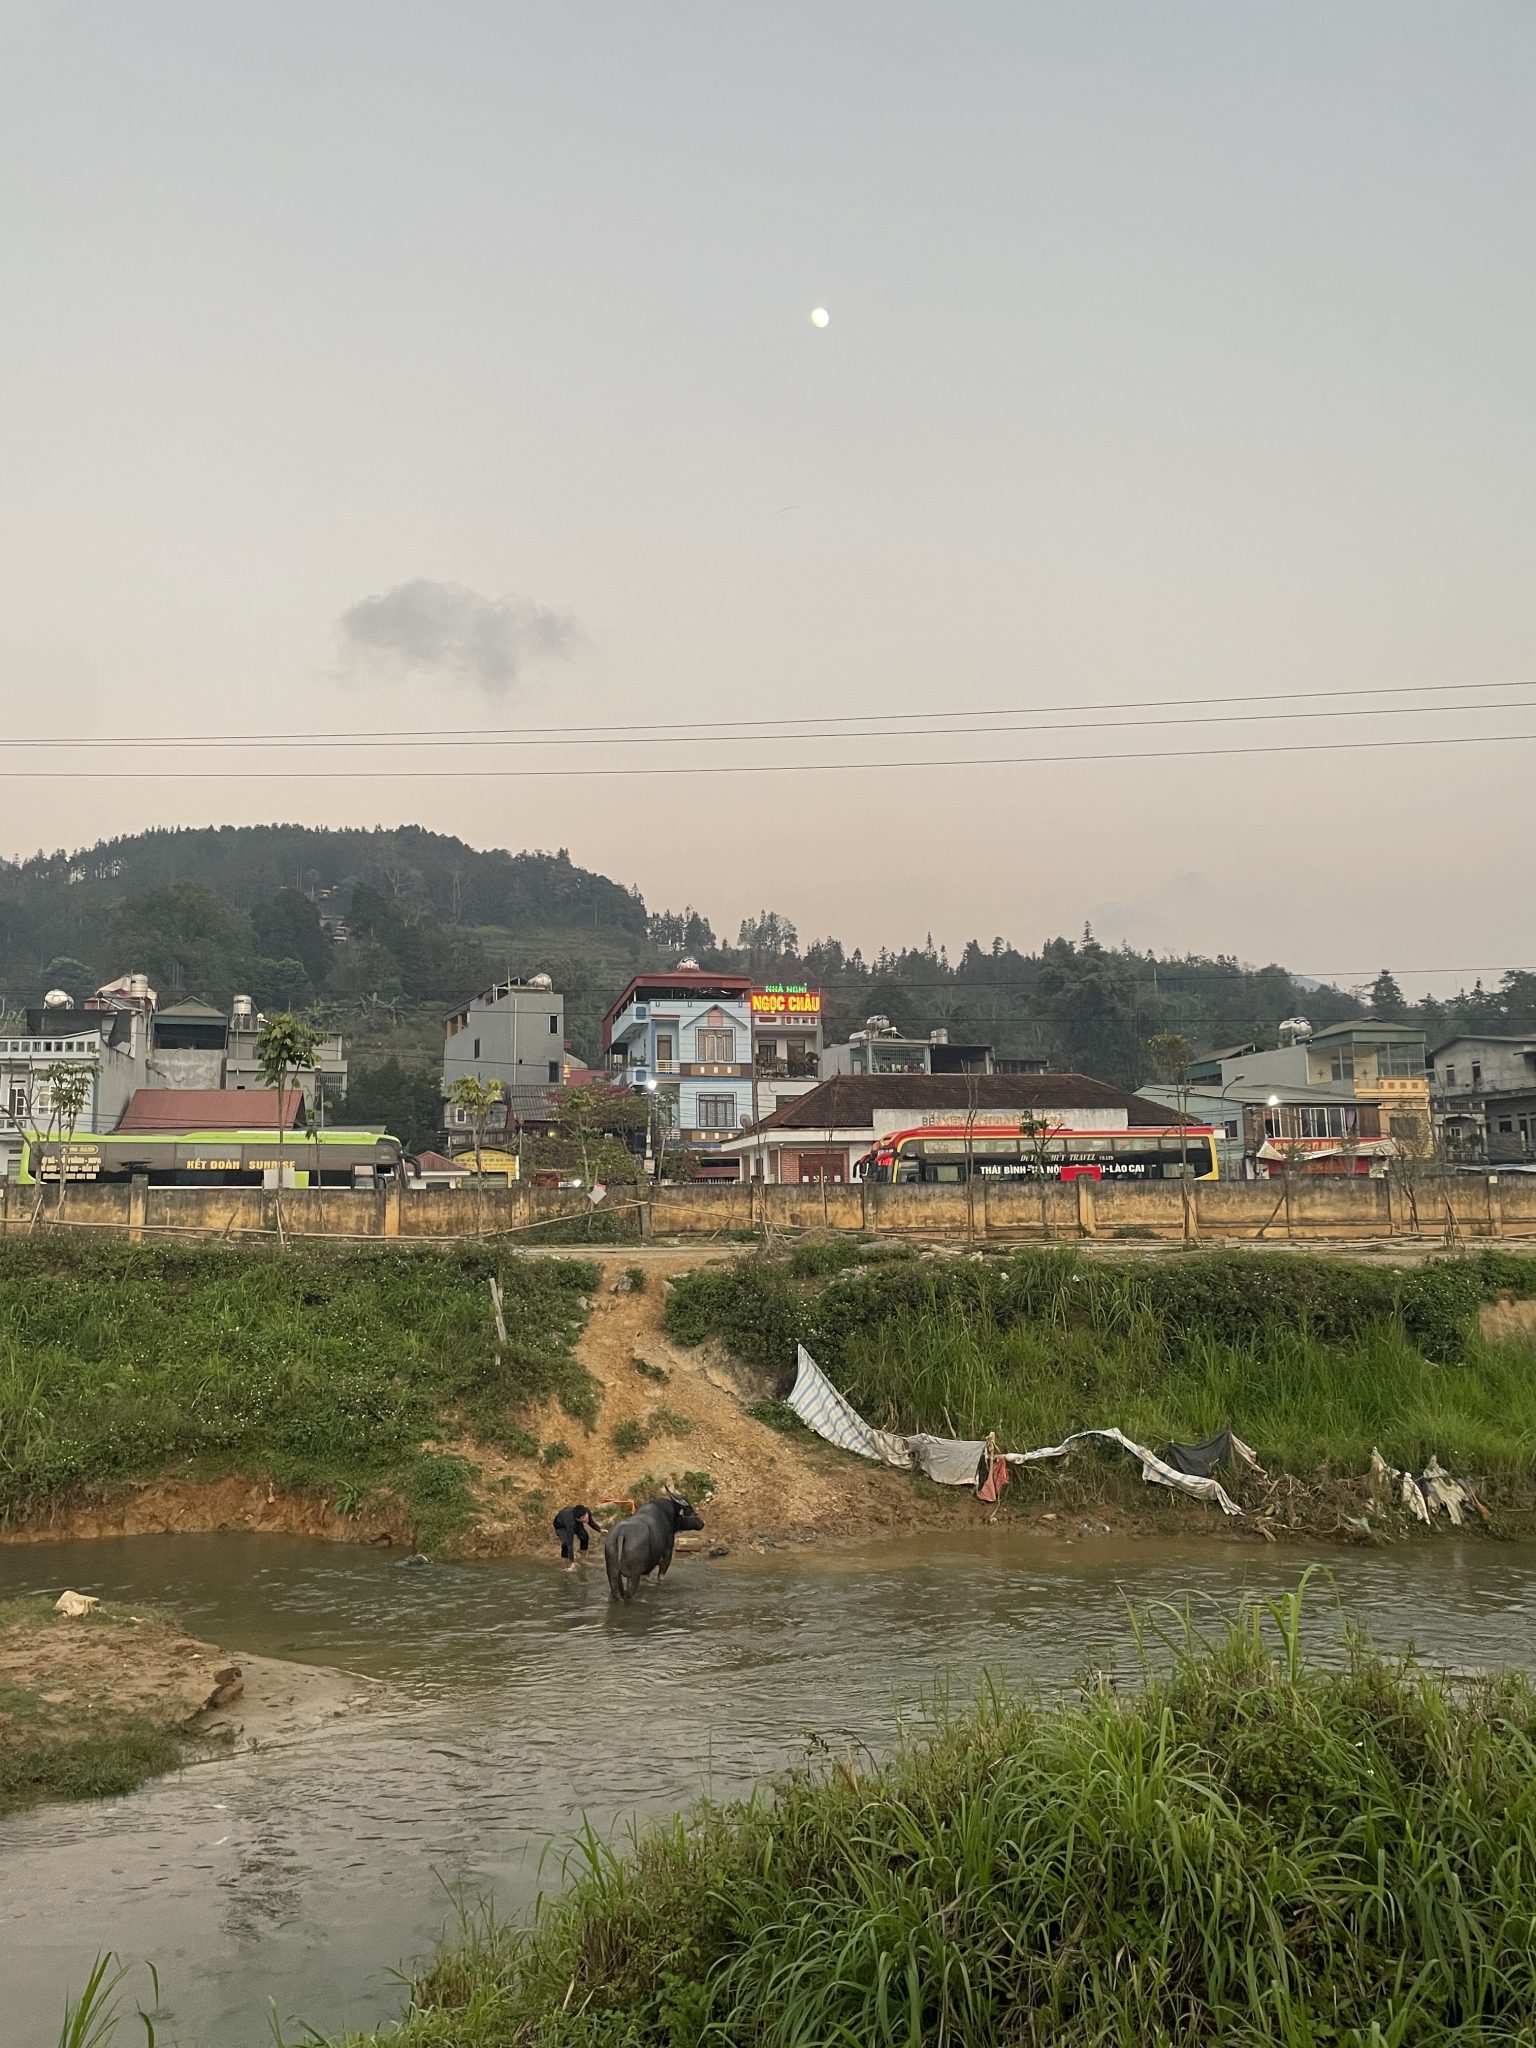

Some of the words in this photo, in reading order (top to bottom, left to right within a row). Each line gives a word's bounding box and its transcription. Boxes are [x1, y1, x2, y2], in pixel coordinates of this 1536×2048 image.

[765, 982, 784, 993] NHÀ
[786, 982, 808, 993] NGHỈ
[752, 995, 786, 1014] NGỌC
[788, 993, 820, 1012] CHÂU
[1069, 1153, 1096, 1161] TRAVEL
[186, 1158, 207, 1169] KẾT
[980, 1163, 1000, 1174] THÁI
